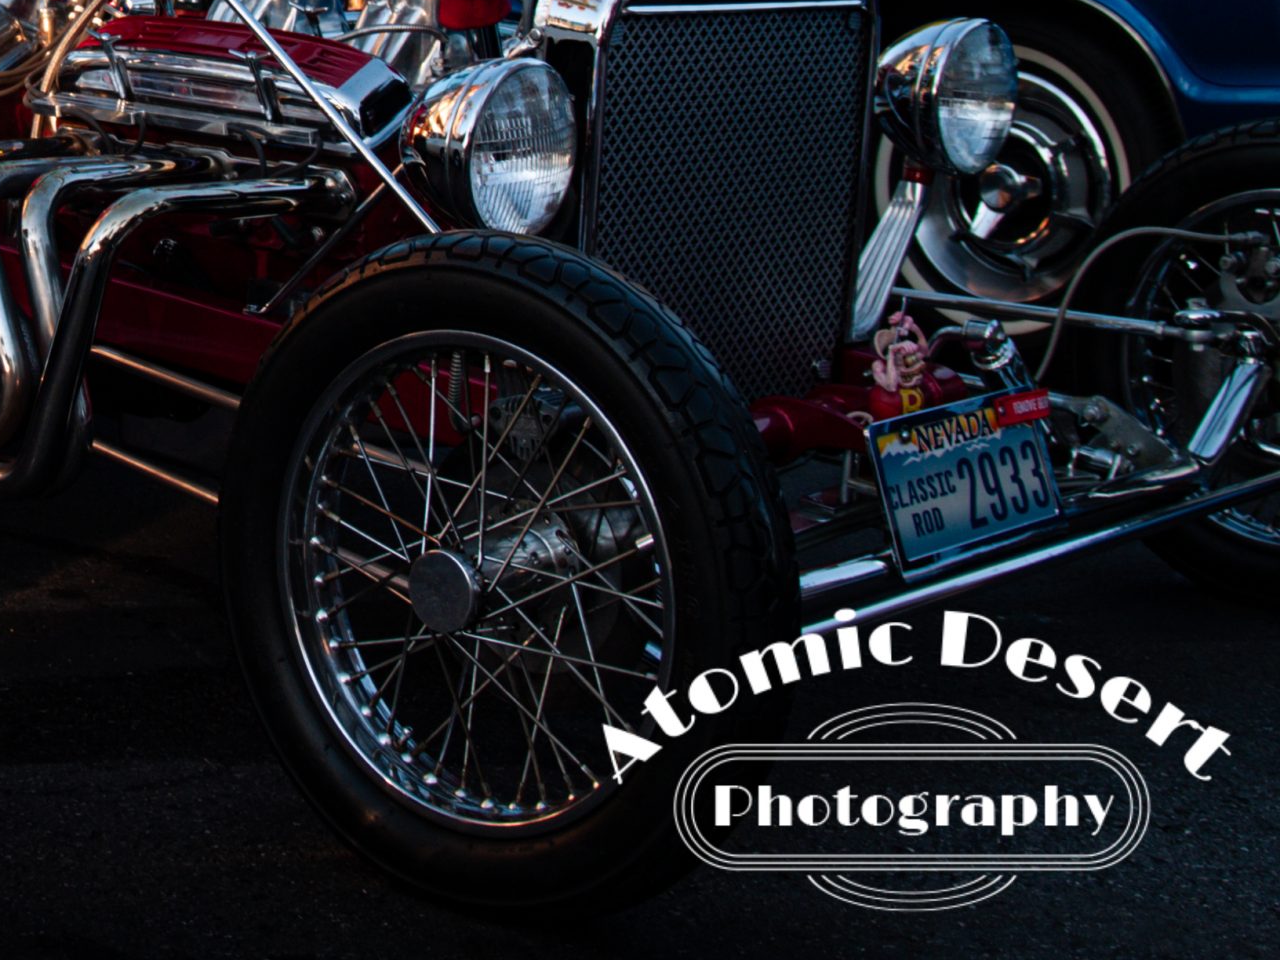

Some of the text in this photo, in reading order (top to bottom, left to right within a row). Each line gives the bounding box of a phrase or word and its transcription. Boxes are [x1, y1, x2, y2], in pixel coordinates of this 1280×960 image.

[911, 409, 996, 453] NEVADA
[888, 469, 957, 512] CLASSIC
[956, 440, 1051, 530] 2933
[912, 507, 945, 538] ROD
